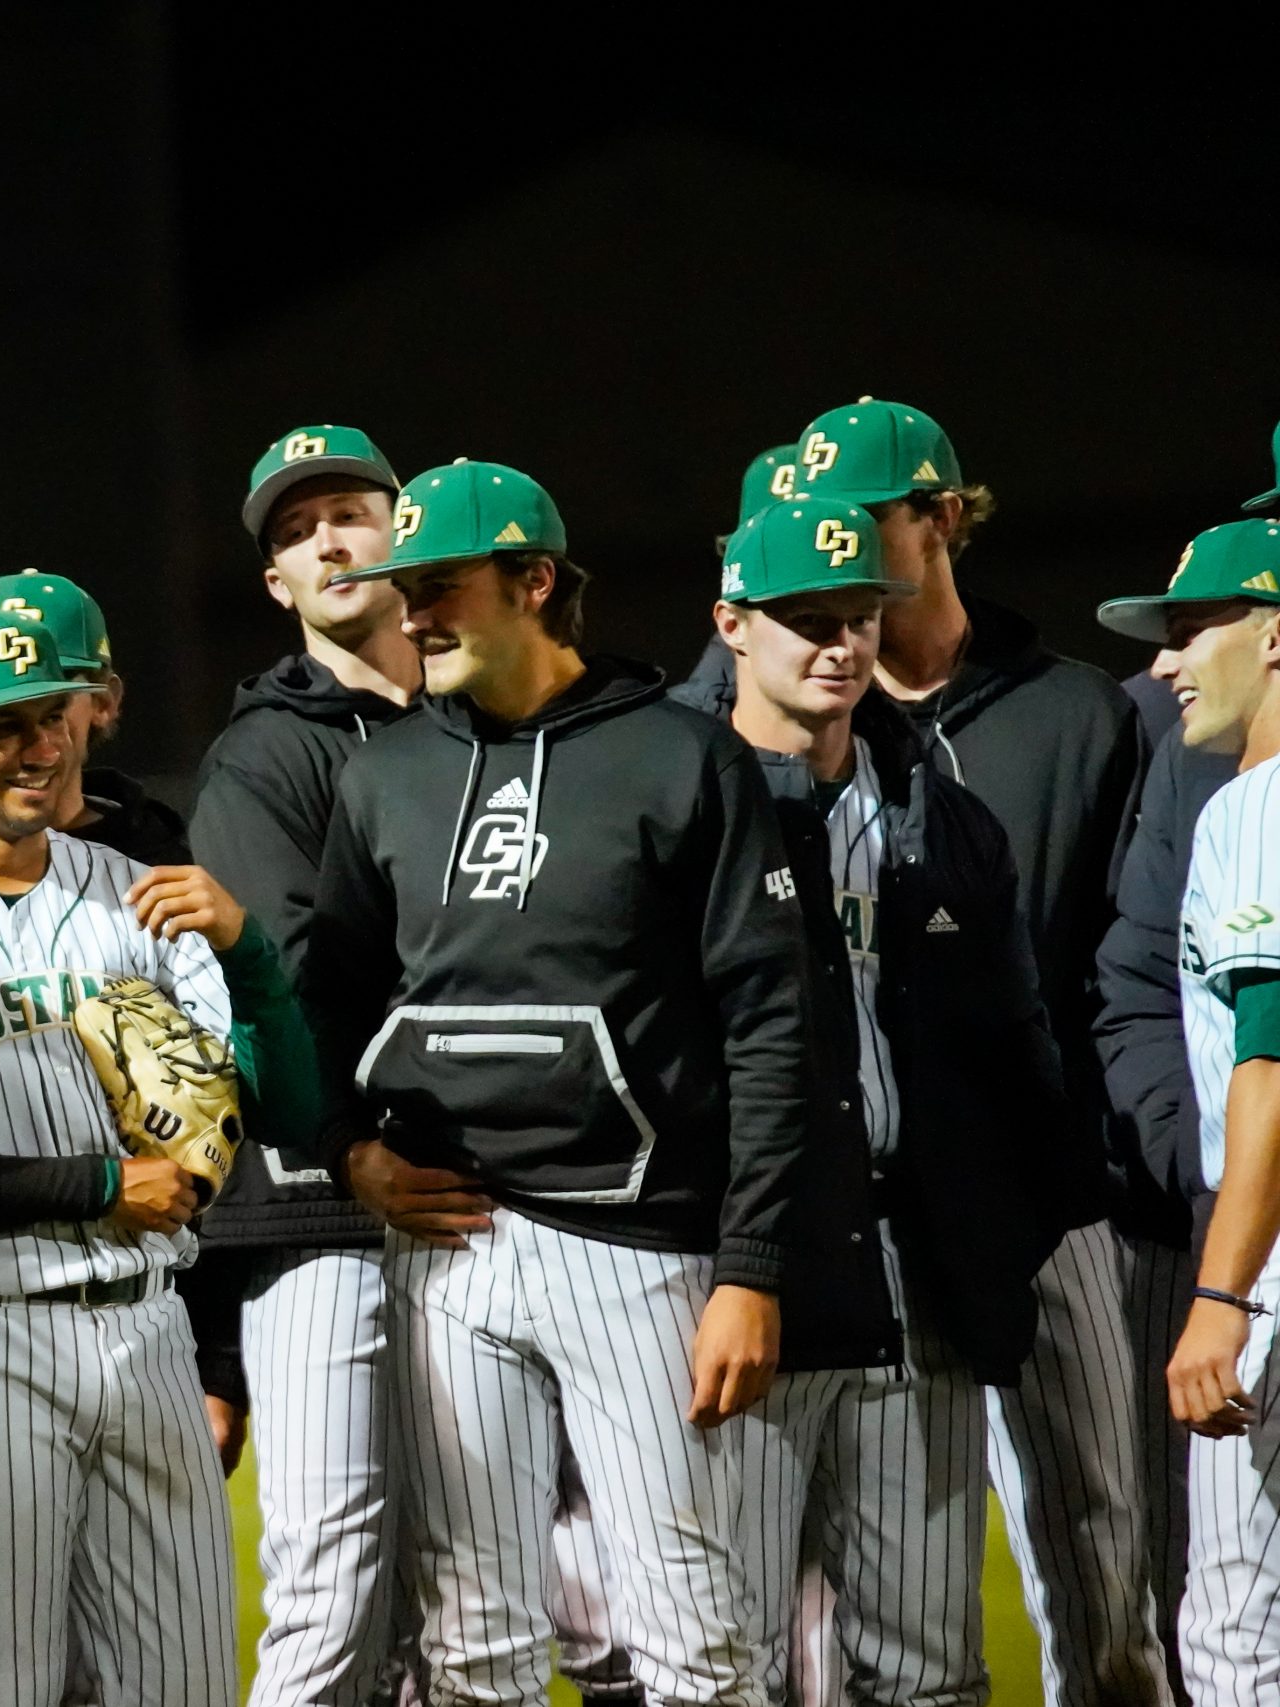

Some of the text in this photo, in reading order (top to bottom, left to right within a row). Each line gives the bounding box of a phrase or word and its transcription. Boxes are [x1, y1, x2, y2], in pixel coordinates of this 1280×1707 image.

[803, 431, 838, 481] CP
[770, 464, 796, 500] C
[393, 494, 423, 547] CP
[815, 519, 859, 567] CP
[486, 797, 531, 809] adida
[765, 866, 797, 901] 45
[926, 923, 960, 933] adidas
[143, 1101, 183, 1141] W
